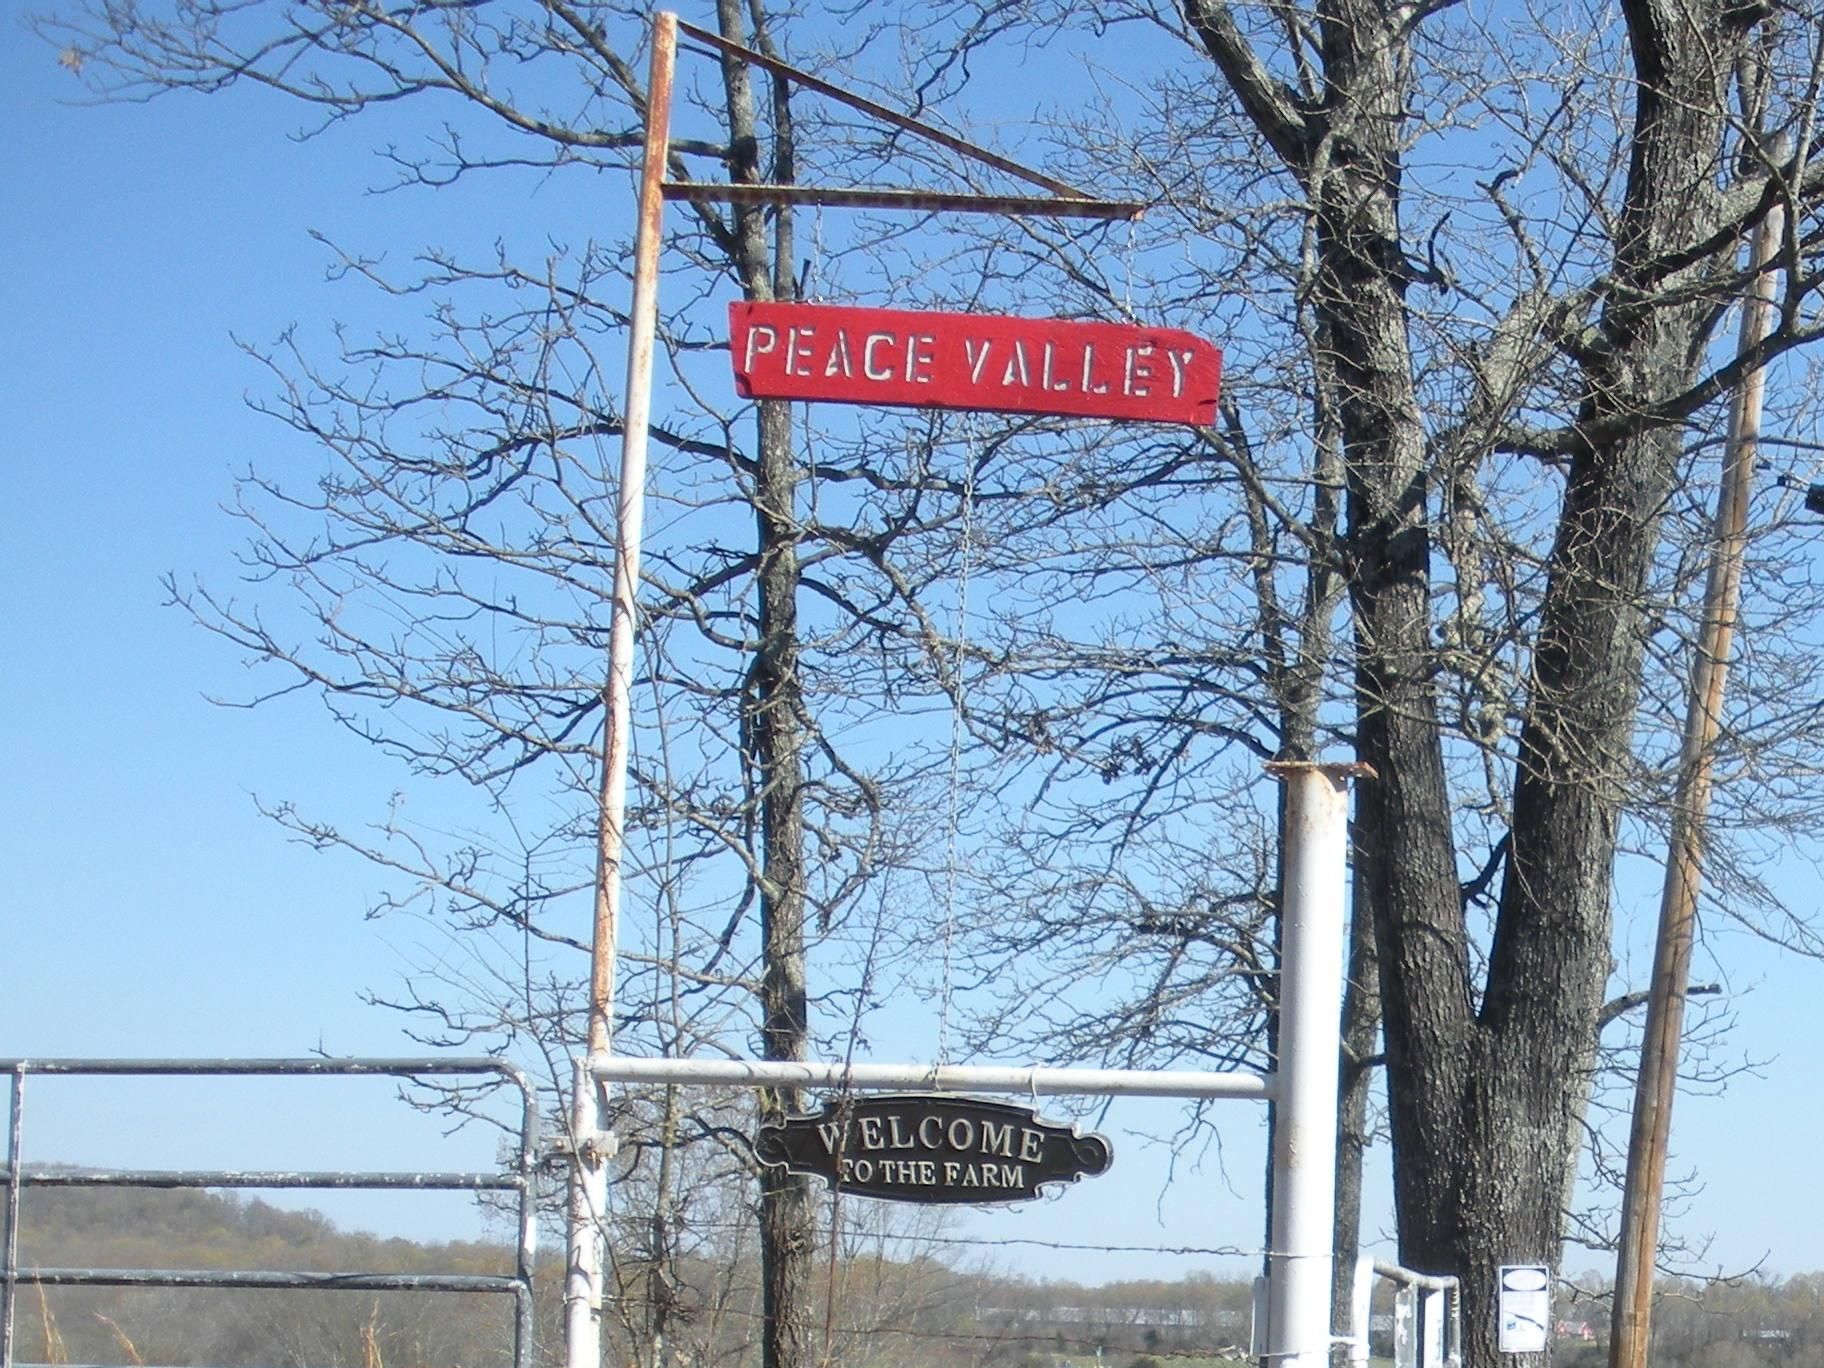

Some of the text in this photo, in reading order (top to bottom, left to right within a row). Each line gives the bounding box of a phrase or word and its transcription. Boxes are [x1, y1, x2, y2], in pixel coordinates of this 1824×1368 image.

[744, 325, 1195, 399] PEACE VALLEY
[817, 1115, 1046, 1163] WELCOME
[878, 1160, 937, 1186] THE
[944, 1162, 1025, 1189] FARM
